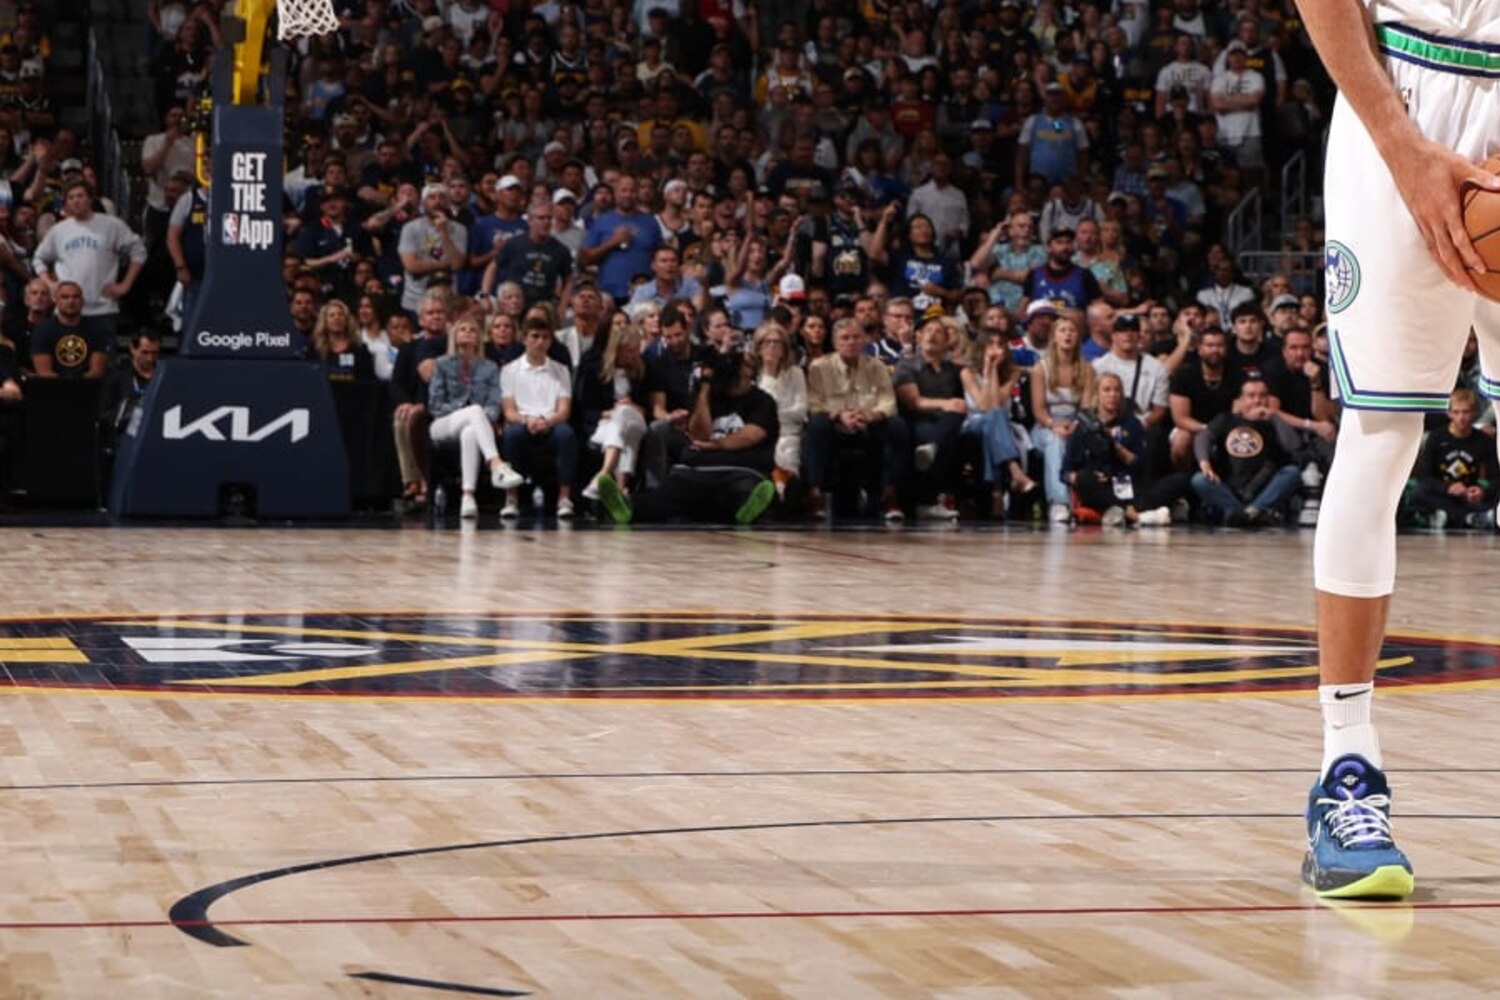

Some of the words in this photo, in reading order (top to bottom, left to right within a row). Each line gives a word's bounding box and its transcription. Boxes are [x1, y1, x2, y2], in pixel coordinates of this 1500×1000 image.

[232, 152, 267, 181] GET
[232, 183, 267, 212] THE
[239, 215, 274, 250] App
[197, 331, 253, 351] Google
[255, 332, 291, 348] Pixel
[162, 403, 310, 444] KIA
